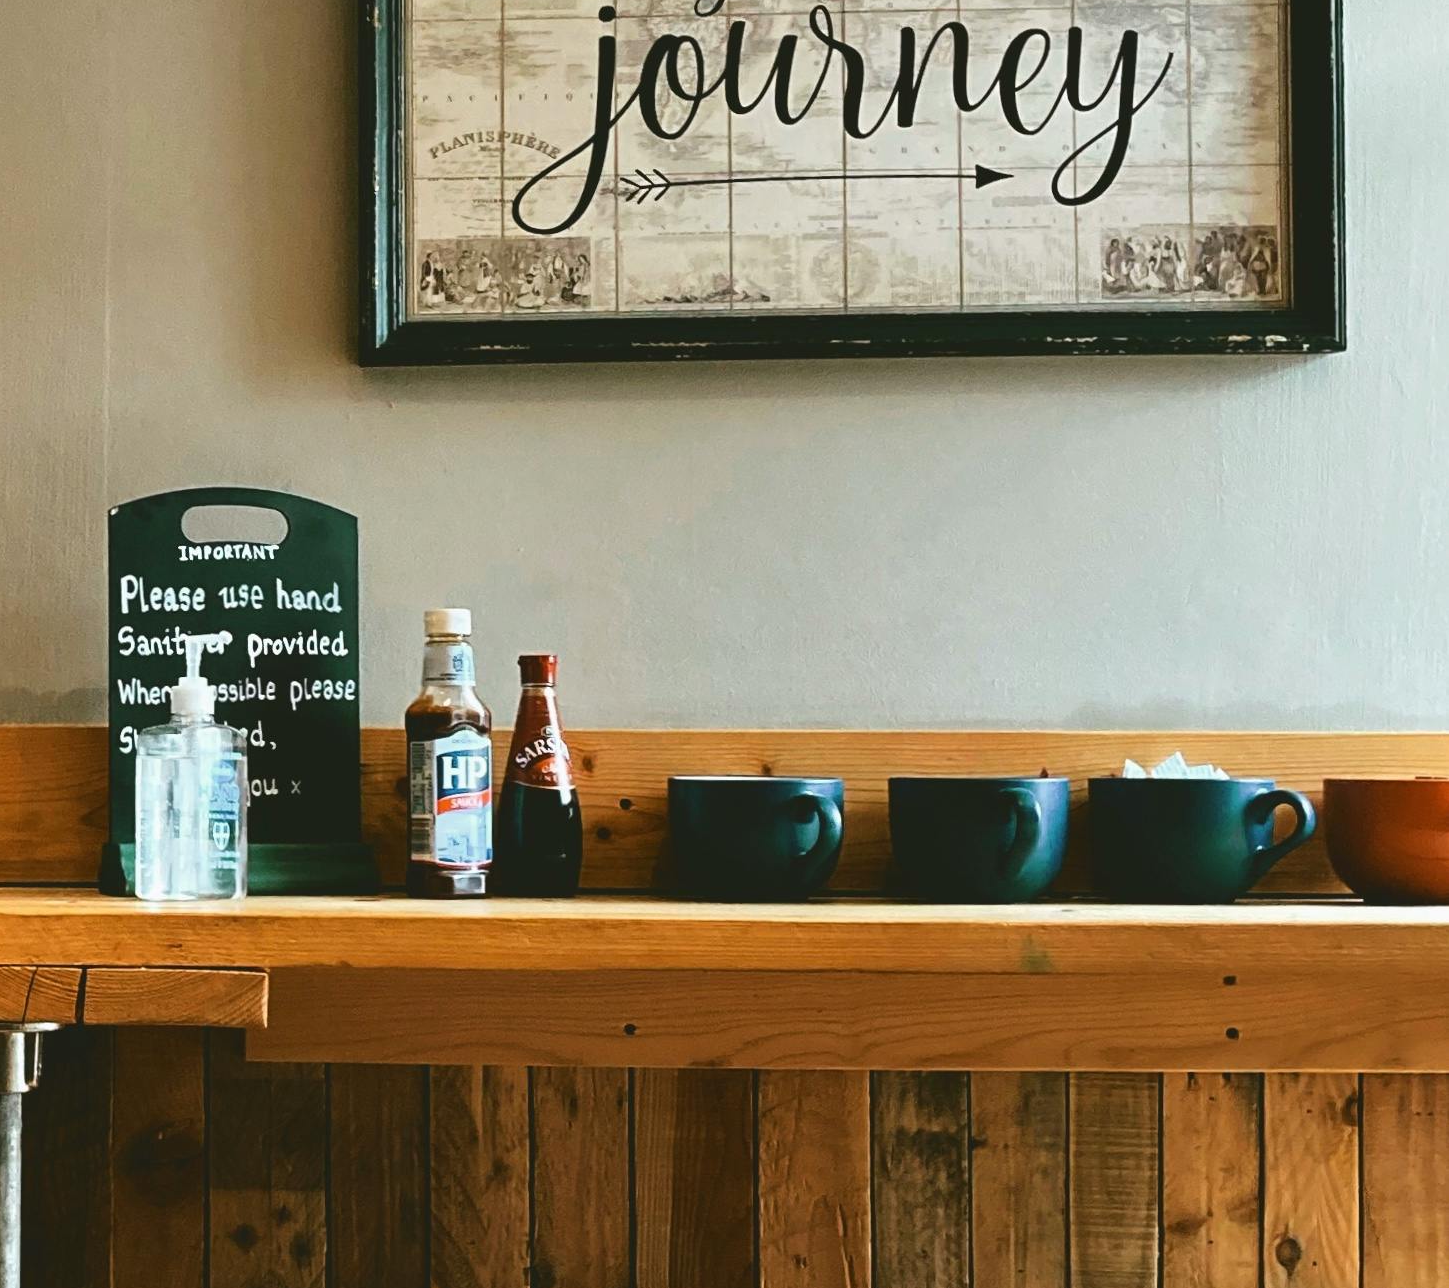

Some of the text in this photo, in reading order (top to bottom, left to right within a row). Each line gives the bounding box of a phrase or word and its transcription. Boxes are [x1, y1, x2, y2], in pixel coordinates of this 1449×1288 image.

[512, 5, 1173, 235] journey
[429, 131, 563, 160] PLANISPHÈRE
[178, 543, 280, 561] IMPORTANT
[120, 575, 342, 614] Please use hand
[247, 630, 349, 668] provided
[290, 677, 357, 710] please
[441, 756, 488, 790] HP
